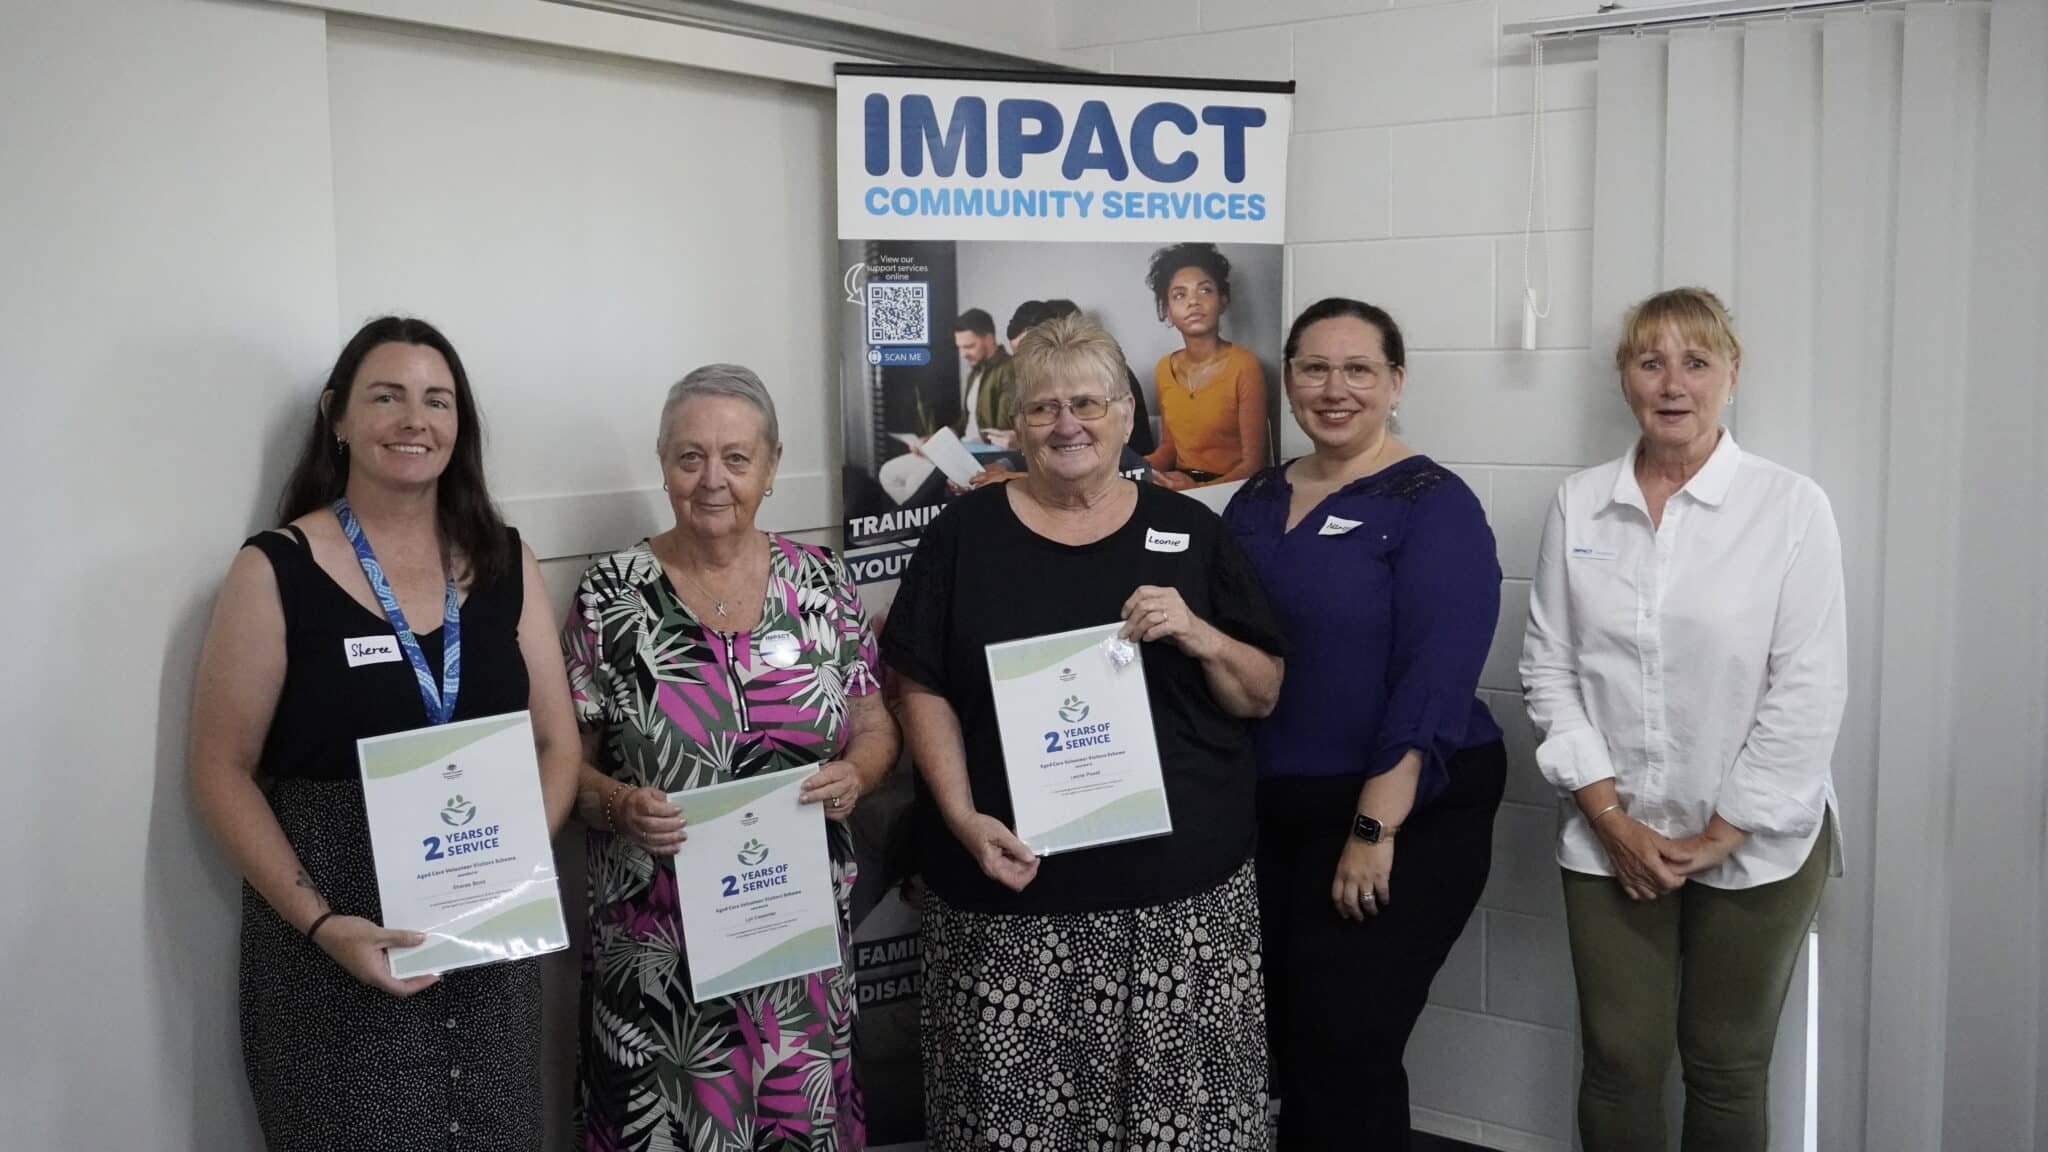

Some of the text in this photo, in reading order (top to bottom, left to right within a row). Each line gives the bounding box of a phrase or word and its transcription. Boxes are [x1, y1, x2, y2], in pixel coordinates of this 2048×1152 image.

[864, 93, 1267, 183] IMPACT
[864, 187, 1266, 221] COMMUNITY SERVICES
[880, 255, 899, 263] View
[866, 265, 896, 273] support
[885, 272, 910, 280] online
[884, 353, 921, 361] SCAN ME
[1148, 535, 1181, 546] Leonie
[351, 643, 392, 657] Sheree
[1064, 722, 1110, 738] YEARS OF
[1044, 731, 1063, 753] 2
[1065, 734, 1111, 750] SERVICE
[446, 825, 499, 843] YEARS OF
[423, 836, 444, 861] 2
[448, 838, 500, 856] SERVICE
[741, 863, 788, 881] YEARS OF
[721, 875, 740, 897] 2
[743, 875, 788, 892] SERVICE
